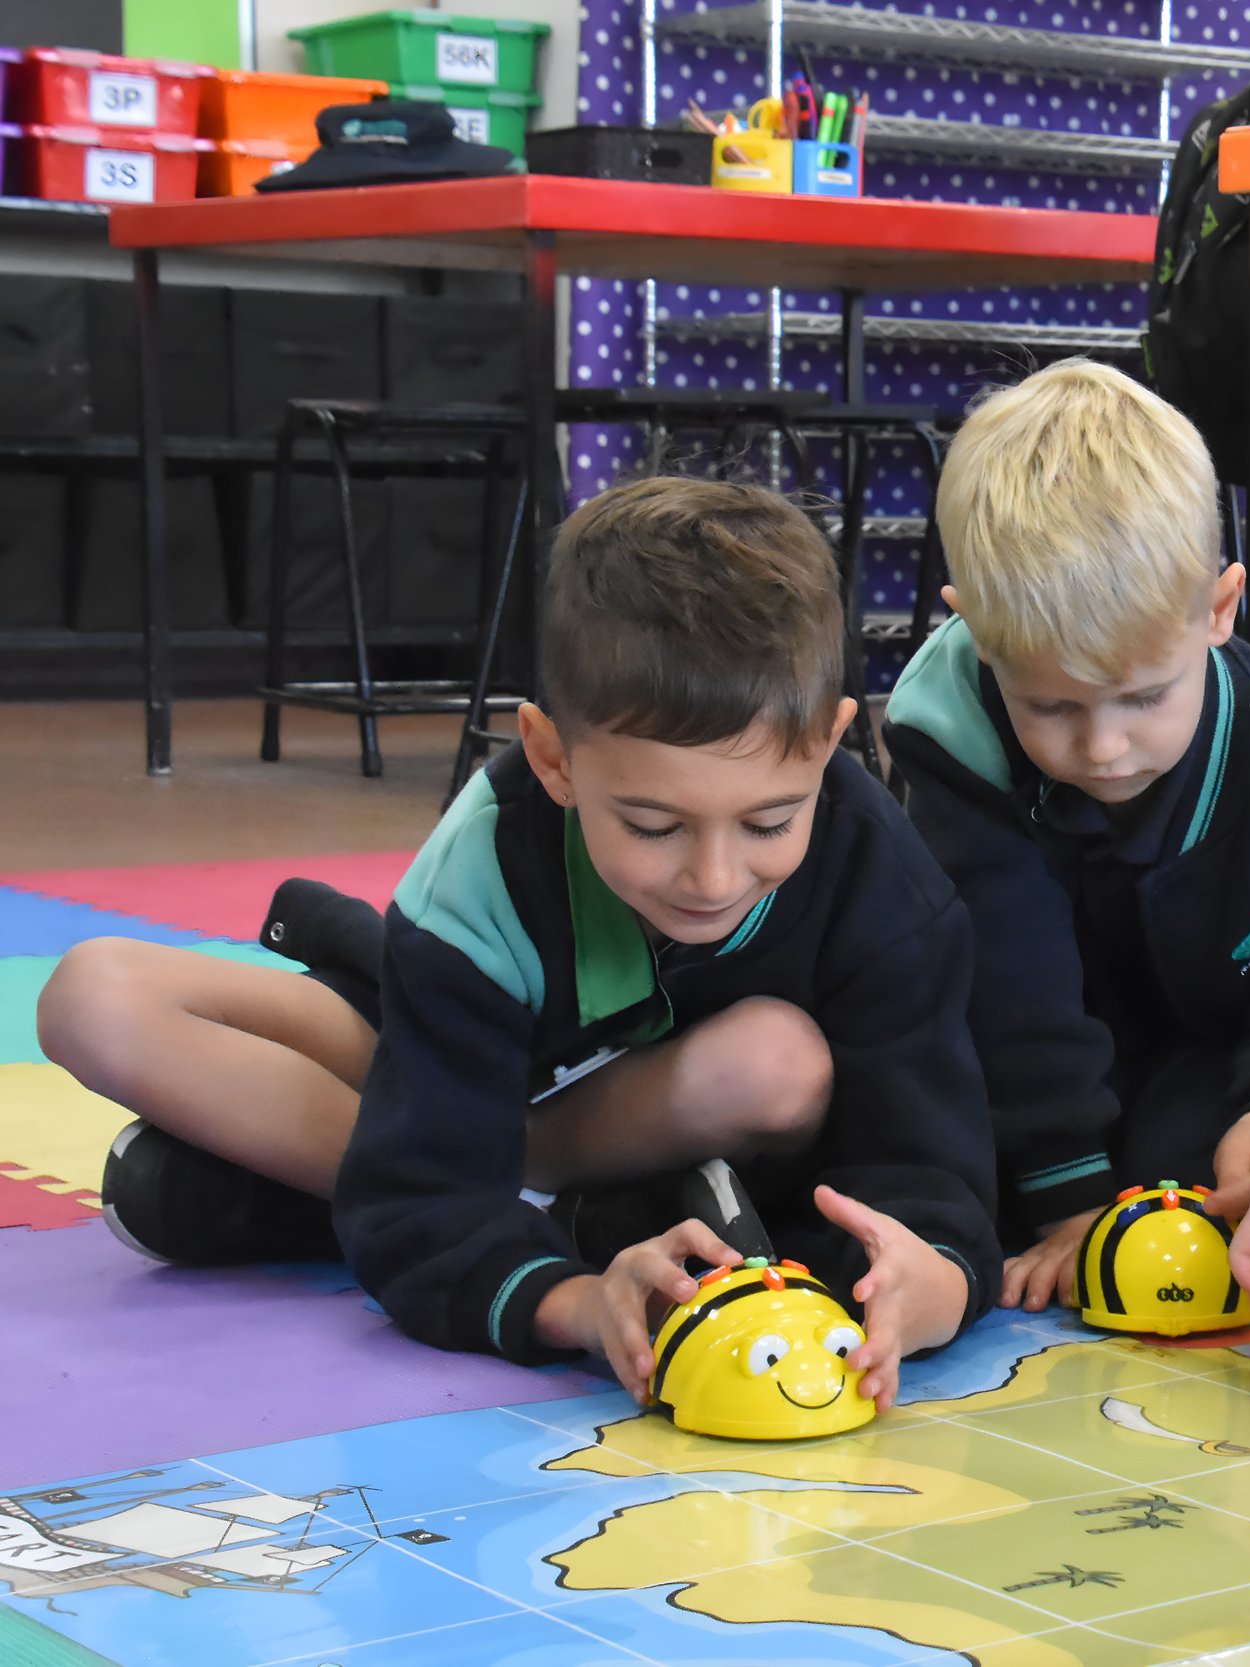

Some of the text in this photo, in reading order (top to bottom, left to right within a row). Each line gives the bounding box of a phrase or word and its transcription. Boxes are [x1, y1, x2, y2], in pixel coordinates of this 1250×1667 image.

[103, 84, 142, 110] 3P
[101, 161, 138, 188] 3S
[1157, 1286, 1194, 1301] tts
